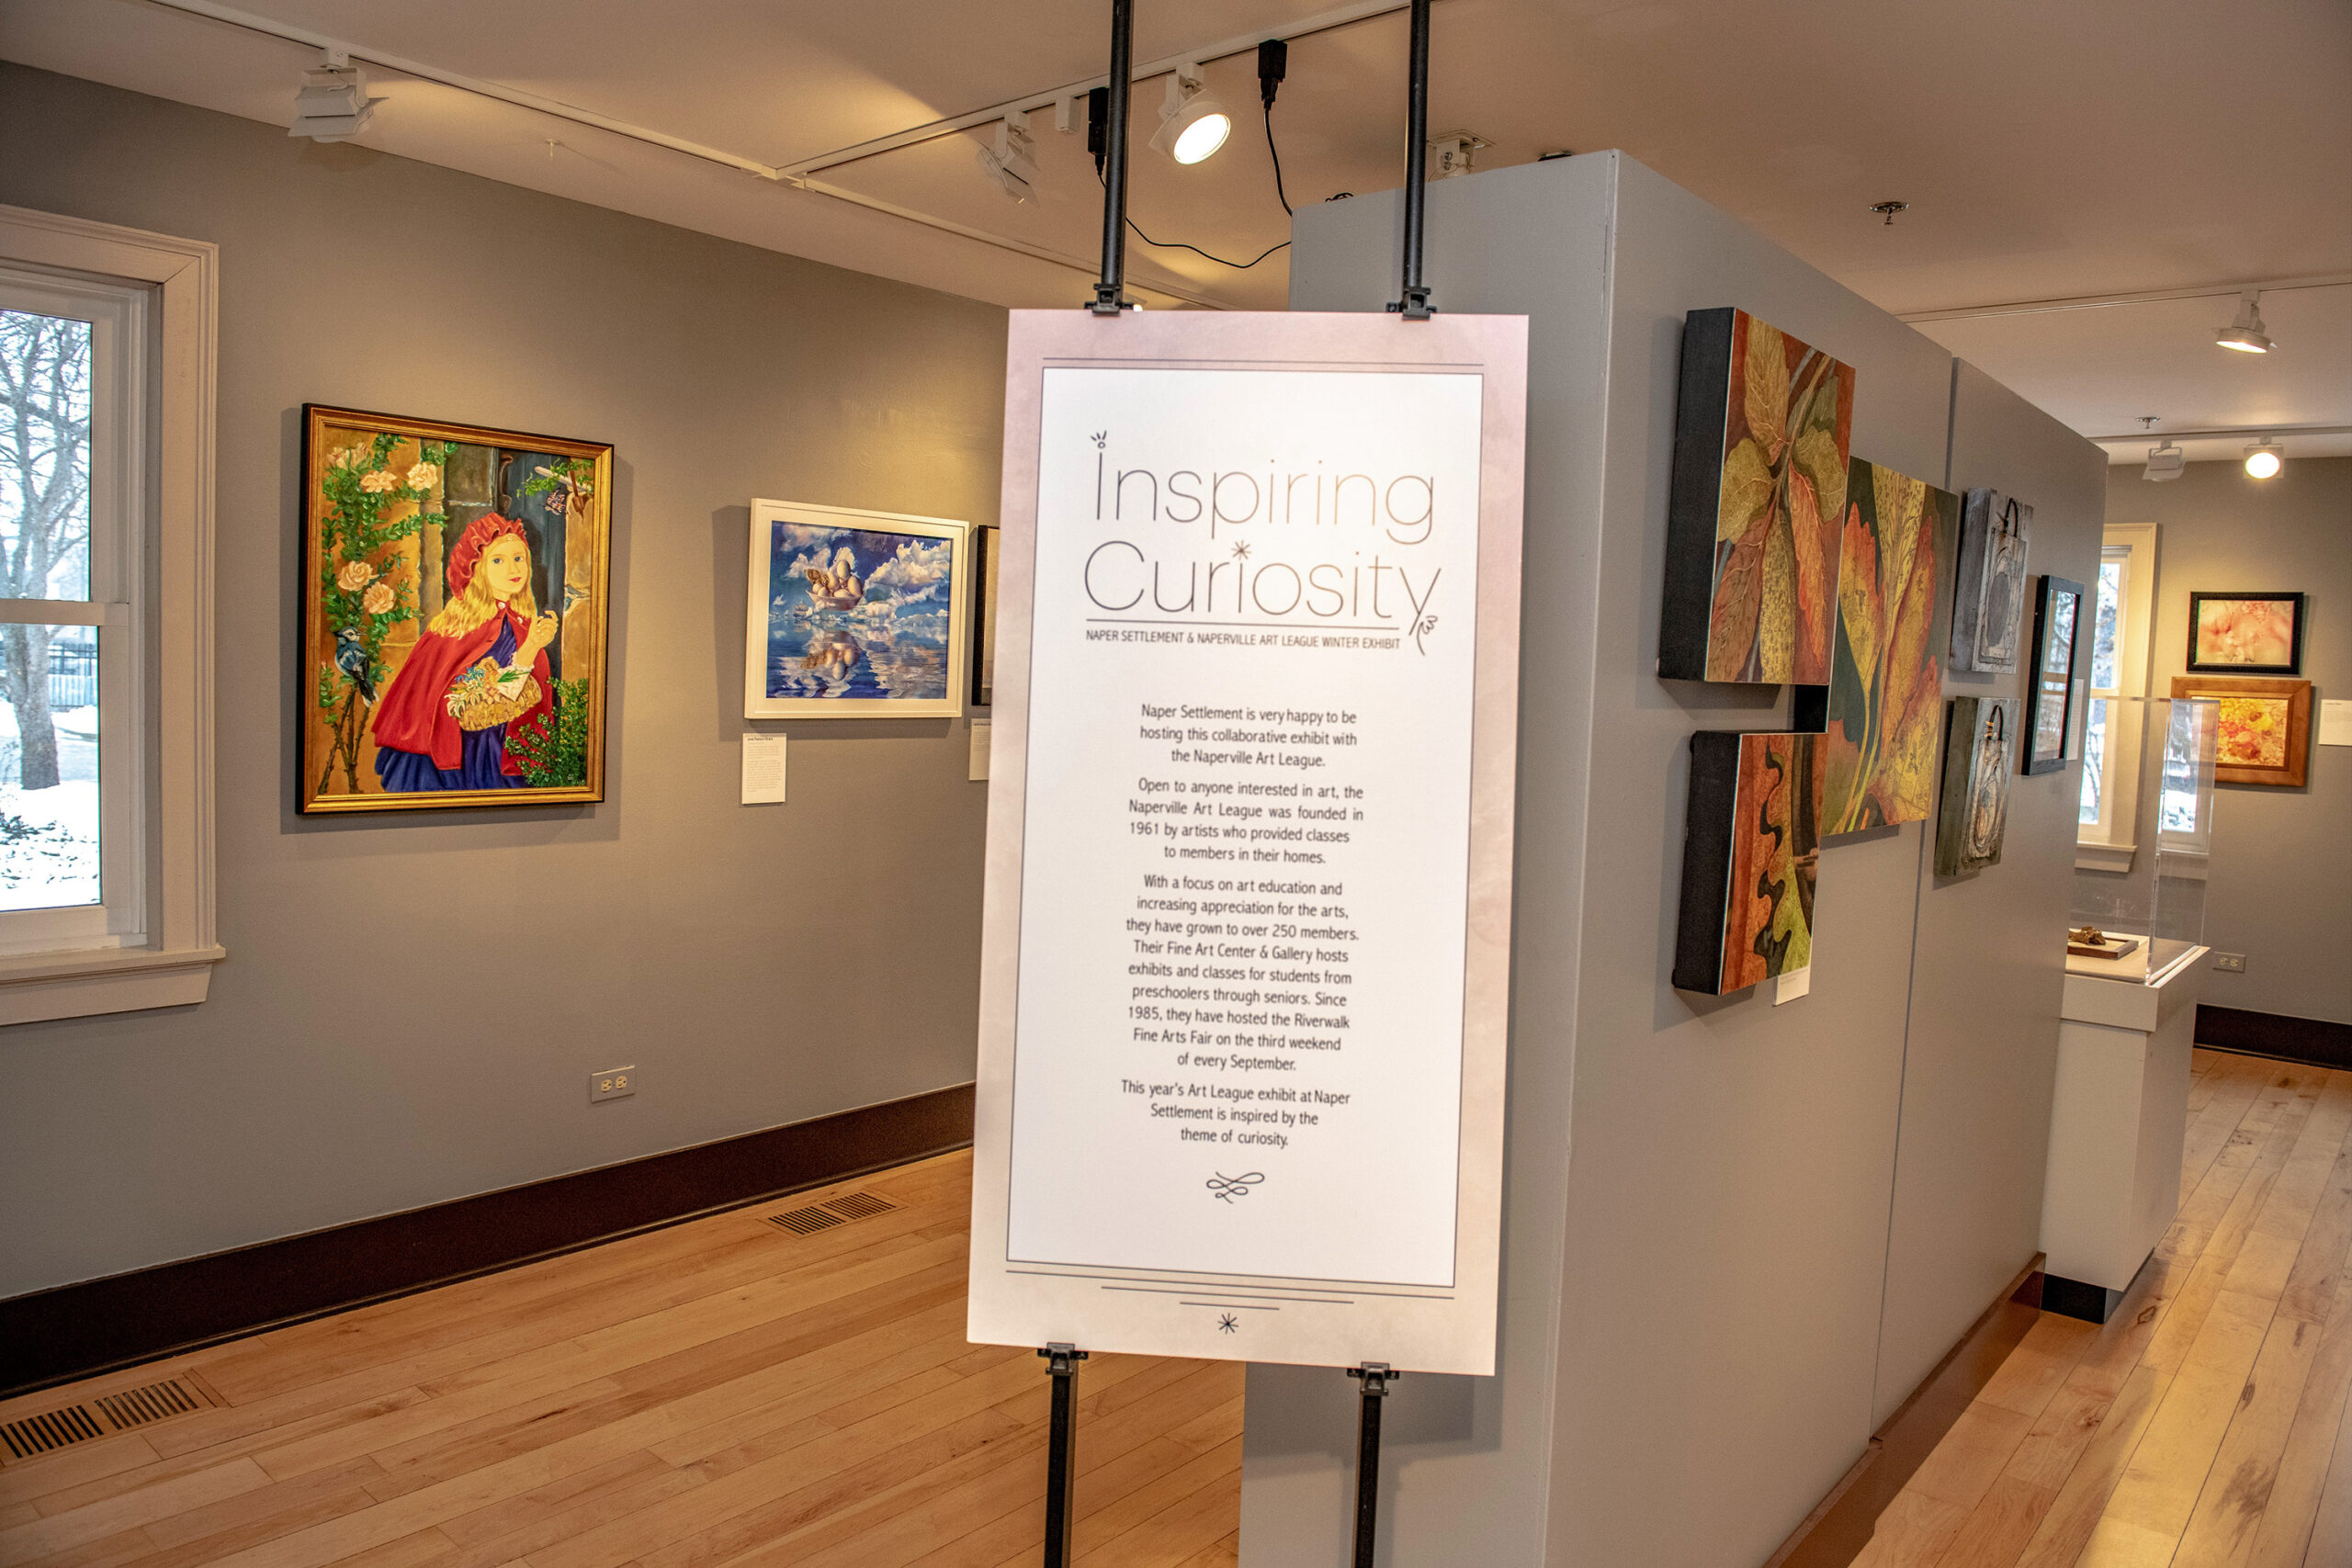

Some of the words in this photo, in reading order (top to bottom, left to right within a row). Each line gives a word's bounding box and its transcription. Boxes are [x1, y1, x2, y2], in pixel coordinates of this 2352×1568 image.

[1096, 442, 1434, 545] Inspiring
[1084, 540, 1442, 636] Curiosity
[1086, 629, 1119, 641] NAPER
[1121, 630, 1183, 643] SETTLEMENT
[1187, 632, 1194, 643] &
[1197, 633, 1255, 645] NAPERVILLE
[1260, 635, 1278, 645] ART
[1282, 636, 1318, 647] LEAGUE
[1322, 637, 1359, 649] WINTER
[1363, 637, 1400, 649] EXHIBIT
[1142, 704, 1177, 720] Naper
[1181, 705, 1243, 720] Settlement
[1247, 707, 1256, 720] is
[1260, 711, 1284, 725] very
[1286, 709, 1323, 727] happy
[1326, 712, 1338, 723] to
[1341, 711, 1356, 724] be
[1140, 726, 1182, 744] hosting
[1188, 728, 1208, 740] this
[1212, 728, 1286, 743] collaborative
[1291, 731, 1329, 745] exhibit
[1332, 733, 1357, 746] with
[1171, 749, 1190, 762] the
[1193, 750, 1252, 766] Naperville
[1256, 751, 1274, 764] Art
[1279, 753, 1325, 770] League.
[1138, 777, 1170, 795] Open
[1174, 781, 1186, 792] to
[1191, 784, 1233, 796] anyone
[1238, 782, 1297, 796] interested
[1303, 784, 1313, 796] in
[1317, 786, 1339, 798] art,
[1344, 786, 1363, 798] the
[1129, 799, 1187, 817] Naperville
[1193, 802, 1212, 816] Art
[1219, 803, 1262, 820] League
[1269, 808, 1292, 818] was
[1298, 806, 1346, 820] founded
[1353, 807, 1363, 820] in
[1130, 821, 1158, 835] 1961
[1164, 822, 1178, 840] by
[1182, 824, 1219, 838] artists
[1223, 826, 1247, 839] who
[1251, 828, 1302, 841] provided
[1306, 829, 1350, 843] classes
[1164, 846, 1176, 858] to
[1180, 846, 1235, 861] members
[1238, 848, 1249, 860] in
[1253, 849, 1279, 862] their
[1283, 850, 1326, 864] homes.
[1144, 874, 1168, 888] With
[1172, 879, 1180, 888] a
[1183, 875, 1215, 891] focus
[1218, 881, 1233, 891] on
[1237, 880, 1254, 891] art
[1259, 880, 1316, 895] education
[1320, 883, 1342, 895] and
[1137, 897, 1196, 916] increasing
[1201, 901, 1273, 916] appreciation
[1278, 902, 1294, 915] for
[1298, 904, 1317, 916] the
[1321, 906, 1349, 919] arts,
[1126, 919, 1151, 935] they
[1155, 919, 1182, 932] have
[1186, 924, 1222, 938] grown
[1227, 923, 1238, 936] to
[1242, 926, 1268, 937] over
[1272, 924, 1296, 938] 250
[1301, 926, 1359, 941] members.
[1134, 939, 1163, 953] Their
[1168, 942, 1192, 955] Fine
[1195, 942, 1214, 956] Art
[1217, 943, 1255, 958] Center
[1260, 945, 1268, 959] &
[1272, 945, 1312, 964] Gallery
[1317, 948, 1349, 963] hosts
[1128, 962, 1172, 976] exhibits
[1177, 964, 1198, 977] and
[1203, 966, 1246, 980] classes
[1250, 966, 1265, 981] for
[1270, 969, 1320, 983] students
[1324, 970, 1351, 984] from
[1133, 986, 1209, 1000] preschoolers
[1214, 988, 1260, 1006] through
[1264, 991, 1310, 1005] seniors.
[1315, 991, 1347, 1007] Since
[1129, 1006, 1162, 1021] 1985,
[1167, 1008, 1192, 1024] they
[1195, 1009, 1223, 1023] have
[1227, 1010, 1267, 1025] hosted
[1272, 1013, 1290, 1026] the
[1295, 1012, 1350, 1029] Riverwalk
[1134, 1027, 1158, 1042] Fine
[1161, 1029, 1186, 1043] Arts
[1191, 1031, 1212, 1043] Fair
[1216, 1035, 1231, 1045] on
[1235, 1033, 1253, 1046] the
[1258, 1034, 1285, 1048] third
[1289, 1037, 1340, 1050] weekend
[1177, 1052, 1189, 1066] of
[1193, 1056, 1227, 1071] every
[1230, 1055, 1295, 1071] September.
[1121, 1079, 1145, 1094] This
[1149, 1082, 1184, 1099] year's
[1188, 1084, 1206, 1097] Art
[1211, 1085, 1254, 1103] League
[1258, 1088, 1296, 1101] exhibit
[1300, 1091, 1312, 1102] at
[1315, 1089, 1351, 1107] Naper
[1151, 1103, 1213, 1120] Settlement
[1217, 1107, 1227, 1121] is
[1231, 1109, 1278, 1124] inspired
[1282, 1111, 1295, 1127] by
[1299, 1111, 1318, 1125] the
[1181, 1127, 1217, 1143] theme
[1221, 1129, 1232, 1143] of
[1238, 1132, 1288, 1149] curiosity.
